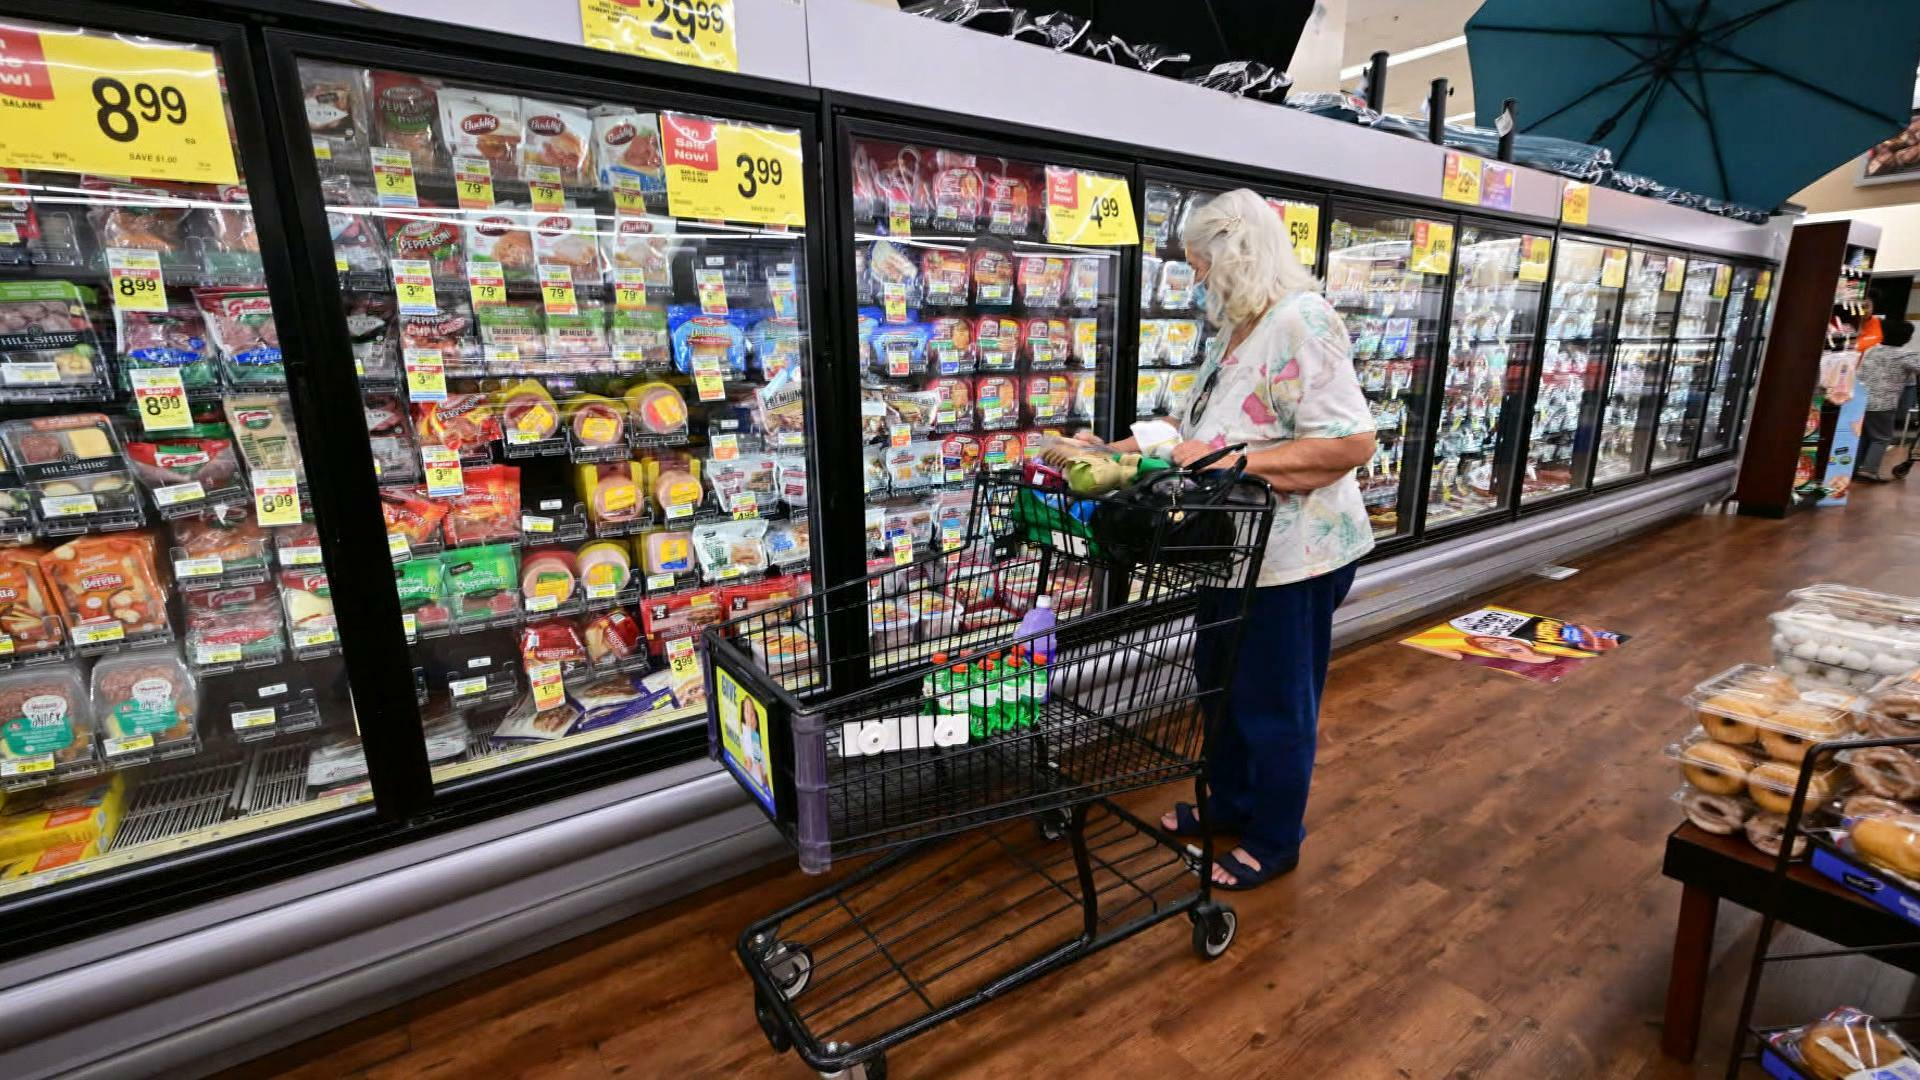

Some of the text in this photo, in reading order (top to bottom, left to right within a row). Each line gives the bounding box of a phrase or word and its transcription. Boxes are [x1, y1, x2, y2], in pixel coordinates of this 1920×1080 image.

[3, 98, 43, 110] SALAME
[464, 117, 497, 132] Buddig
[129, 152, 152, 162] SAVE
[674, 149, 709, 162] Now!
[400, 231, 452, 249] PEPPERONI
[1, 334, 78, 346] HILLSHIRE
